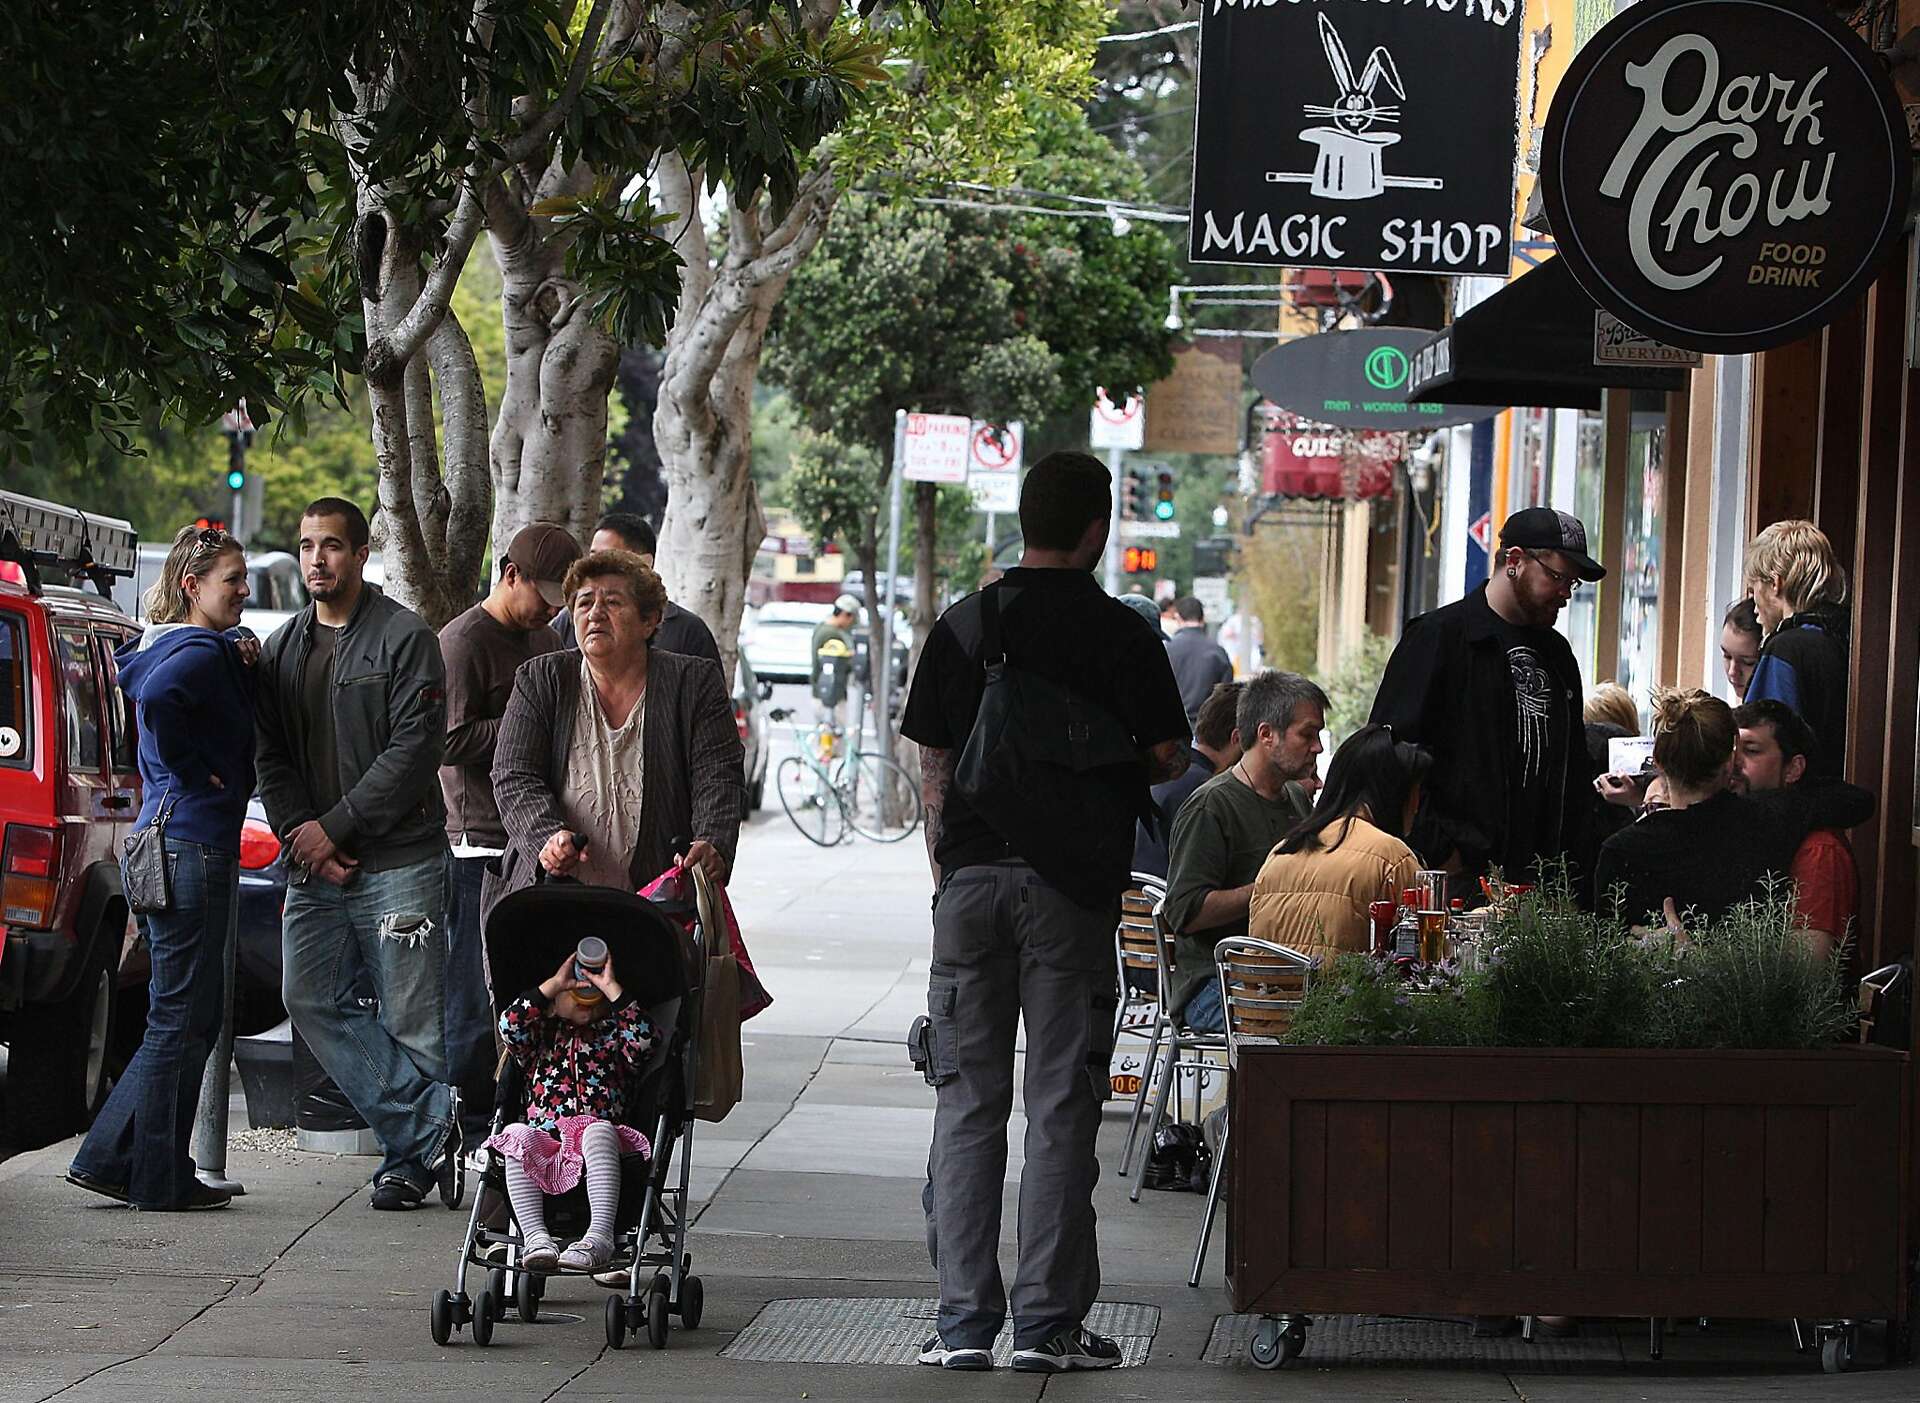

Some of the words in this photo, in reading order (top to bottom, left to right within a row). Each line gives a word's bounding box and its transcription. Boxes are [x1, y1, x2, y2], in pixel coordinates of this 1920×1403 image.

[1599, 33, 1828, 199] Park
[1628, 121, 1836, 291] Chow
[1201, 209, 1347, 259] MAGIC
[1380, 217, 1502, 266] SHOP
[1758, 243, 1827, 265] FOOD
[1747, 265, 1822, 288] DRINK
[1604, 346, 1692, 361] EVERYDAY
[1324, 400, 1351, 412] men
[1363, 401, 1408, 414] women
